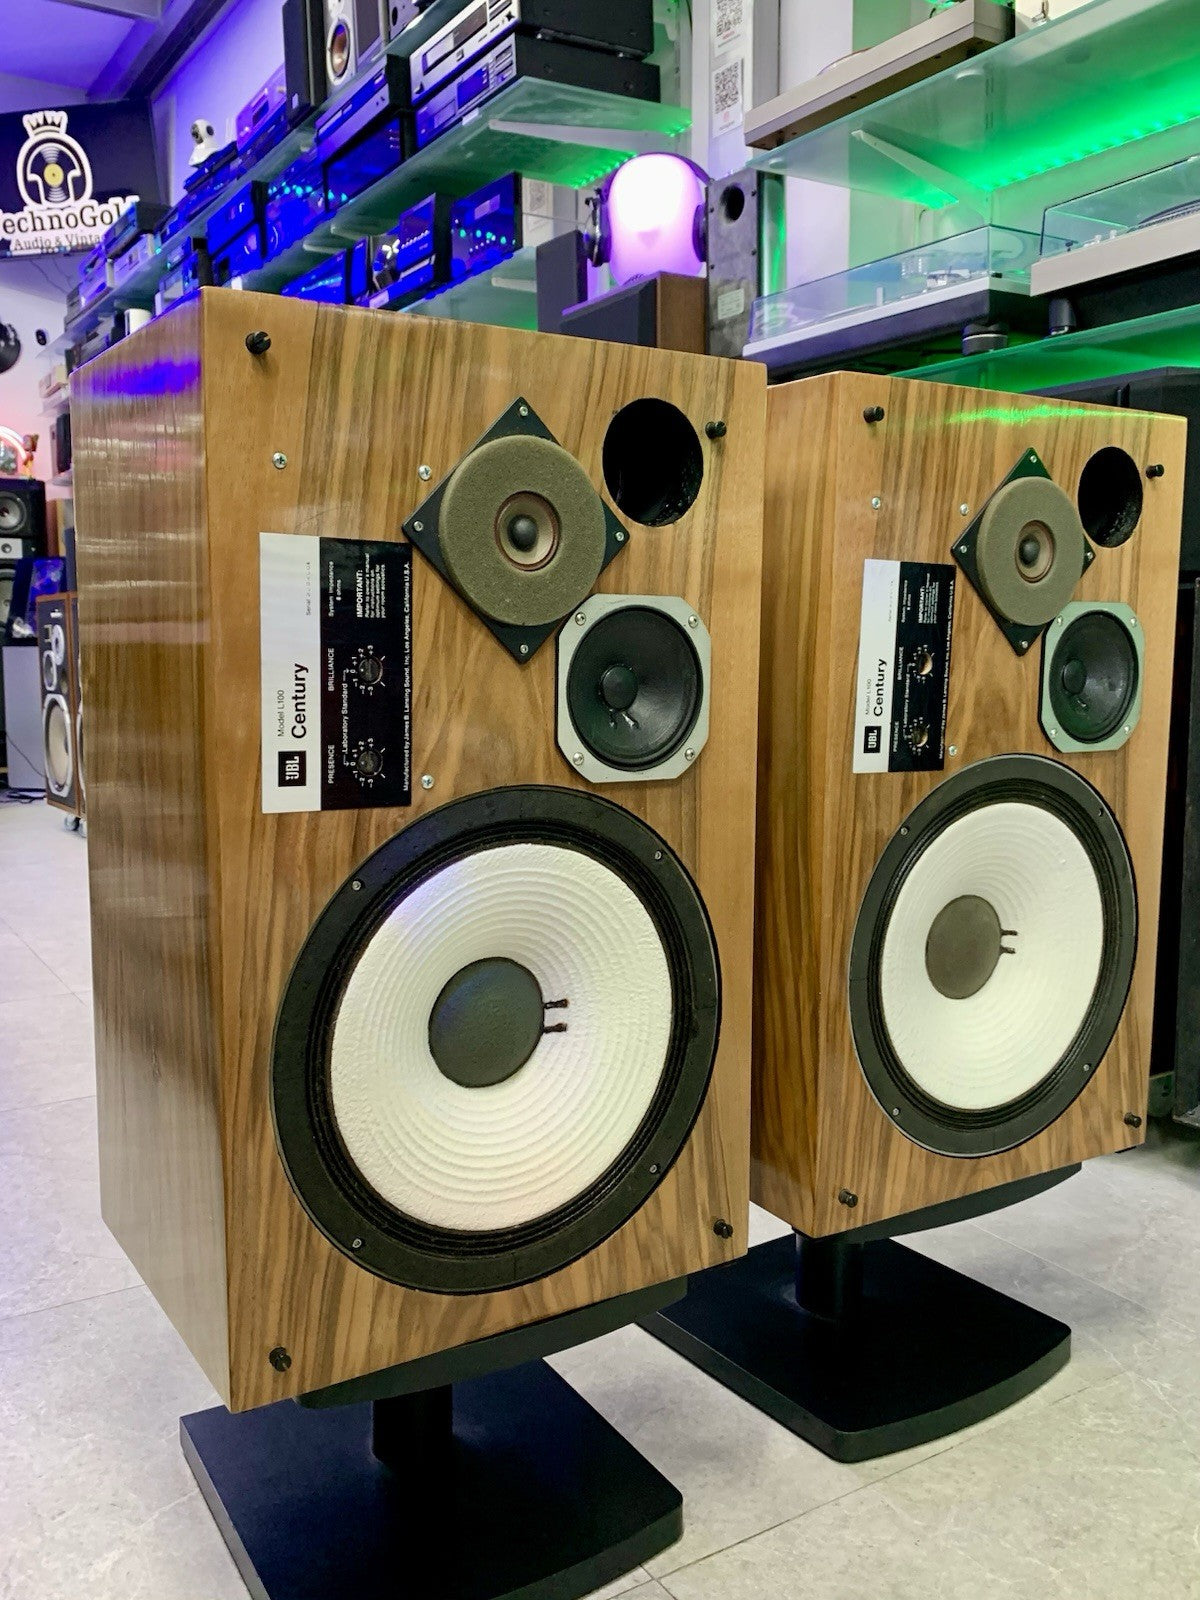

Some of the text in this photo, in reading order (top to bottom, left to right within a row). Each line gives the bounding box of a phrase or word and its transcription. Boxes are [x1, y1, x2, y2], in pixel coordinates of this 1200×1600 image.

[291, 663, 308, 739] Century
[873, 659, 887, 716] Century
[286, 756, 299, 780] JBL
